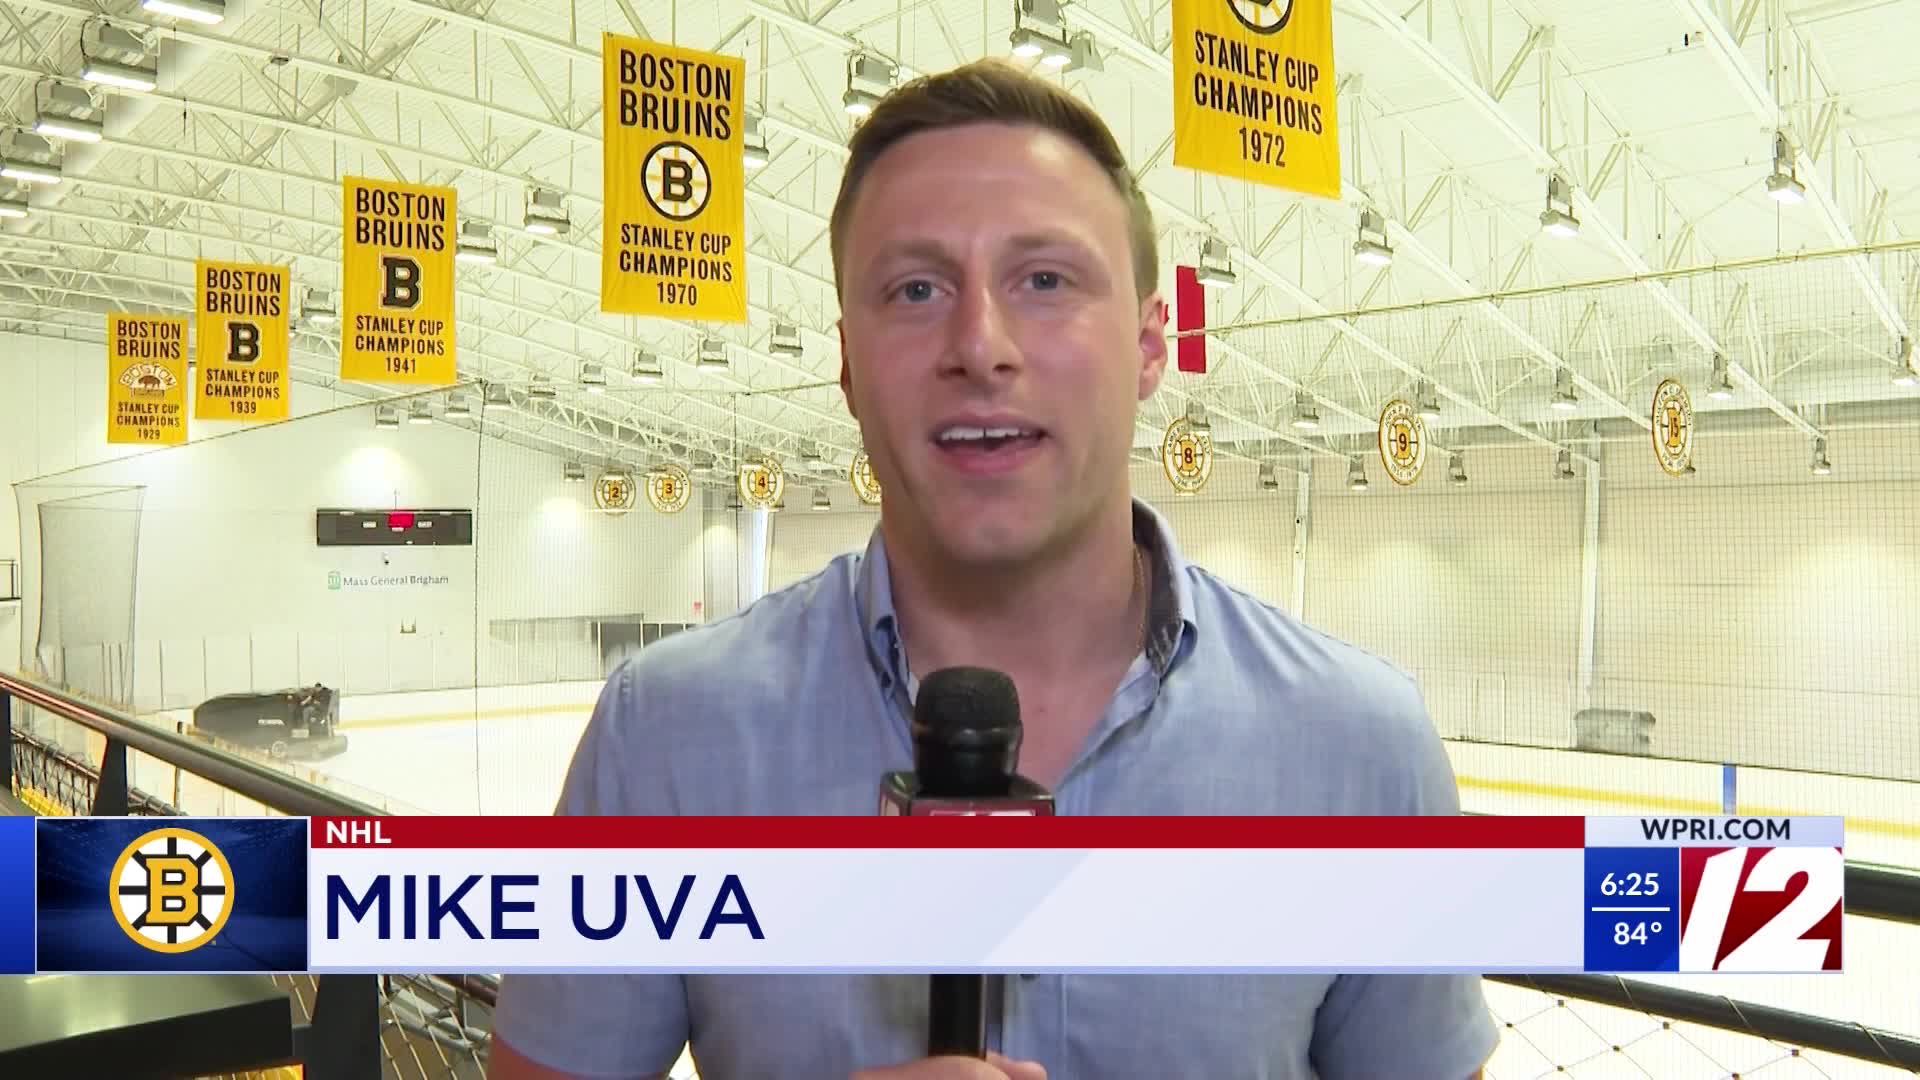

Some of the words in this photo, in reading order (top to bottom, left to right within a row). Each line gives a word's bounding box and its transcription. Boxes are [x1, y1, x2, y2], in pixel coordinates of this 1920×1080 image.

[1195, 30, 1279, 84] STANLEY
[1285, 57, 1319, 93] CUP
[620, 48, 731, 101] BOSTON
[1194, 72, 1322, 135] CHAMPIONS
[620, 89, 731, 141] BRUINS
[1239, 127, 1286, 167] 1972
[662, 159, 693, 203] B
[356, 187, 446, 222] BOSTON
[356, 215, 445, 252] BRUINS
[621, 223, 695, 253] STANLEY
[701, 232, 731, 257] CUP
[619, 250, 732, 282] CHAMPIONS
[206, 268, 281, 294] BOSTON
[382, 256, 422, 308] B
[206, 291, 280, 317] BRUINS
[657, 281, 697, 306] 1970
[117, 319, 181, 340] BOSTON
[355, 315, 415, 335] STANLEY
[419, 318, 443, 336] CUP
[117, 339, 181, 360] BRUINS
[228, 322, 260, 361] B
[355, 335, 445, 356] CHAMPIONS
[385, 357, 416, 374] 1941
[206, 369, 255, 384] STANLEY
[258, 371, 279, 385] CUP
[205, 384, 280, 400] CHAMPIONS
[117, 402, 159, 414] STANLEY
[161, 403, 179, 414] CUP
[230, 401, 257, 414] 1939
[117, 415, 180, 428] CHAMPIONS
[137, 428, 161, 440] 1929
[1398, 432, 1407, 452] 9
[1184, 447, 1193, 464] 8
[611, 487, 620, 498] 2
[665, 483, 673, 493] 3
[758, 477, 766, 487] 4
[343, 577, 368, 586] Mass
[370, 575, 408, 586] General
[409, 575, 449, 587] Brigham
